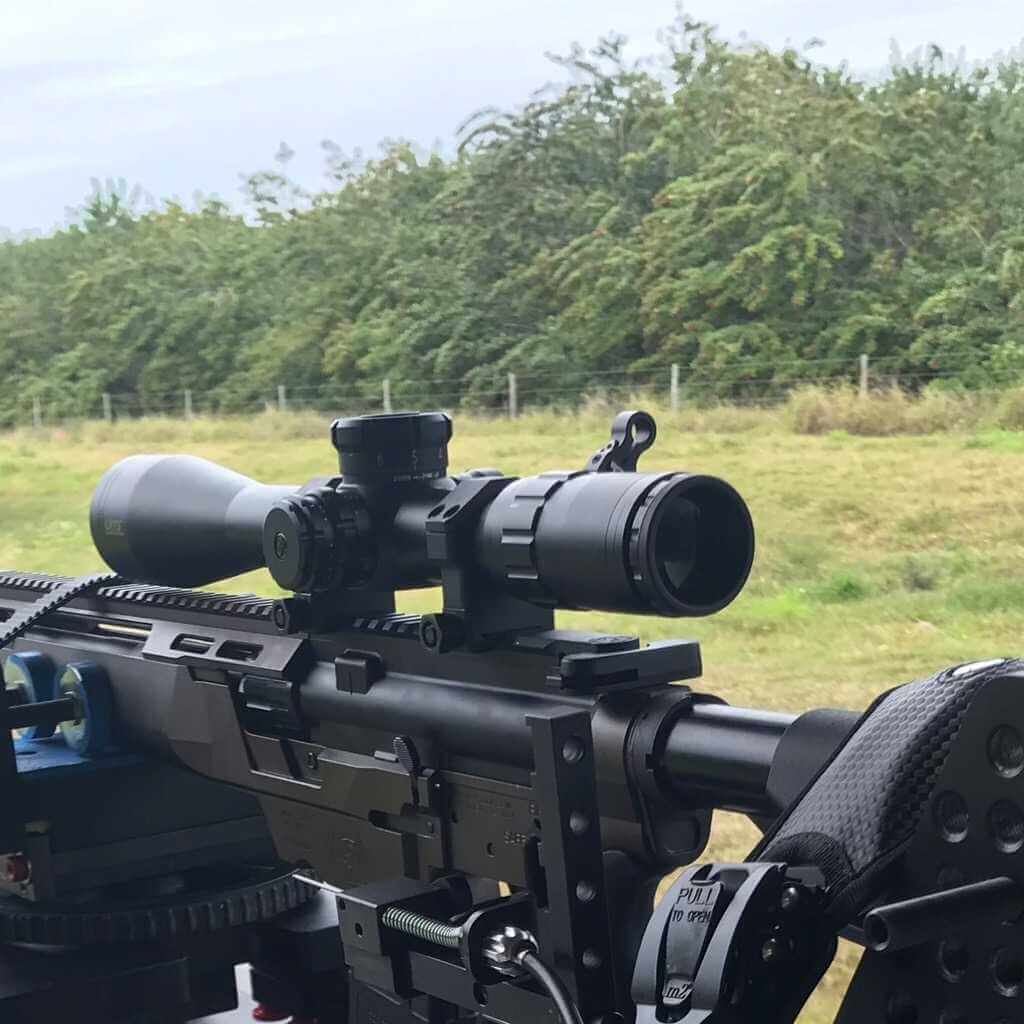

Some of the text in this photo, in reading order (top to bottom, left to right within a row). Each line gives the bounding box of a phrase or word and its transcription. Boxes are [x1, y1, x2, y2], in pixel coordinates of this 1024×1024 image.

[676, 888, 714, 906] PULL
[672, 910, 711, 924] TO OPEN
